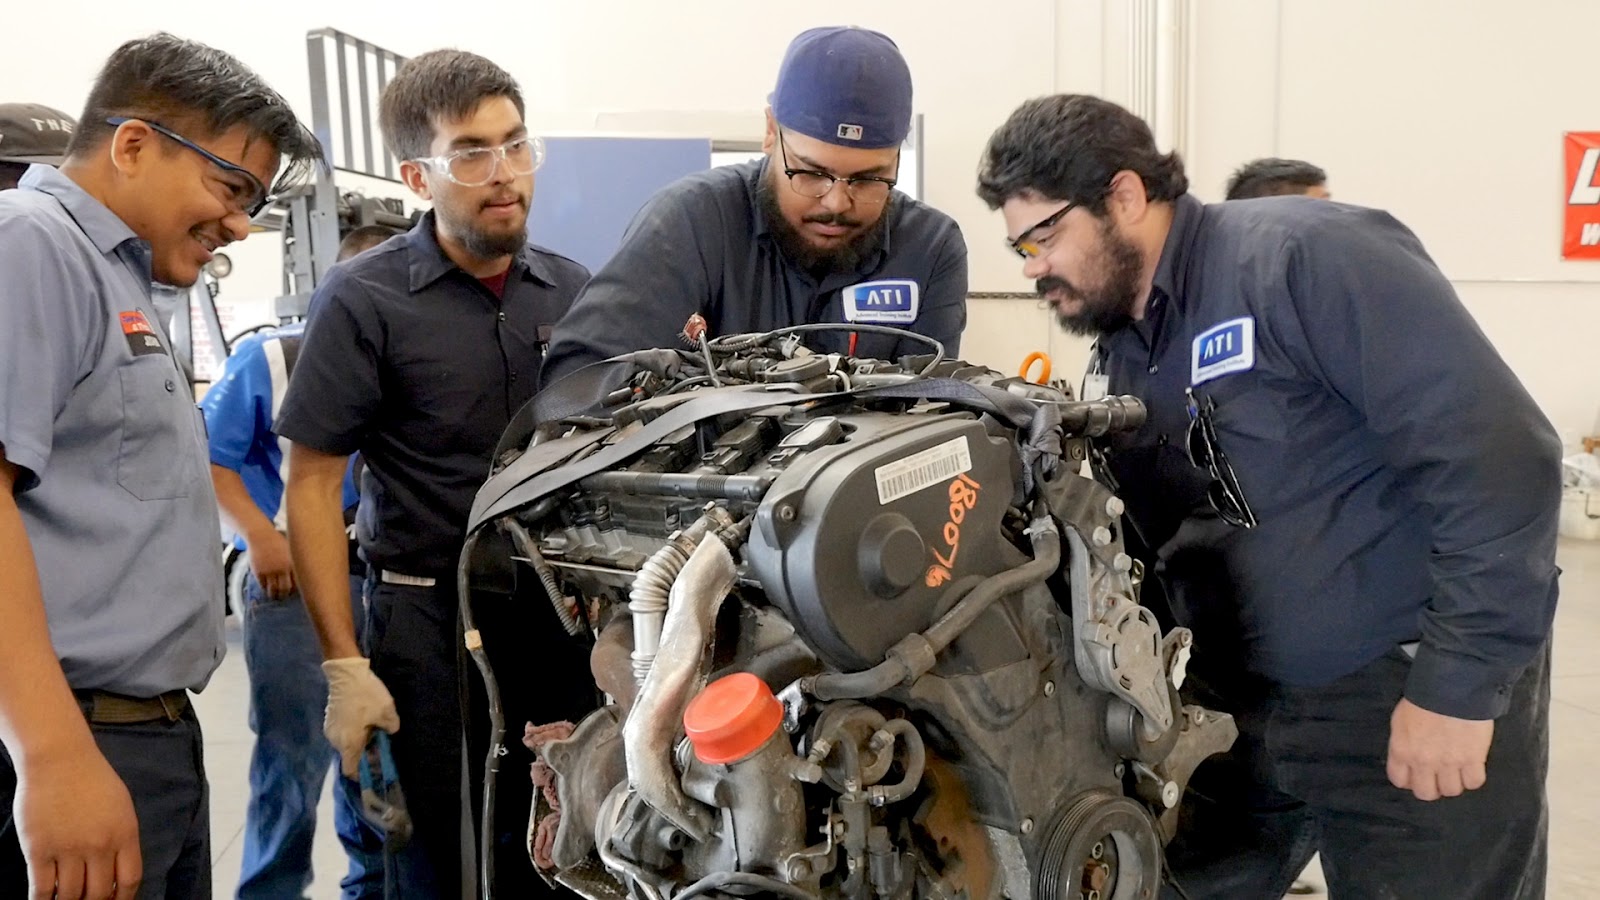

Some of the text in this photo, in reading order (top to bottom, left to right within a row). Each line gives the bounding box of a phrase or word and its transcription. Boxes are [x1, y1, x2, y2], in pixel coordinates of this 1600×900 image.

[30, 117, 73, 134] THE
[867, 289, 902, 305] ATI
[1203, 331, 1233, 360] ATI
